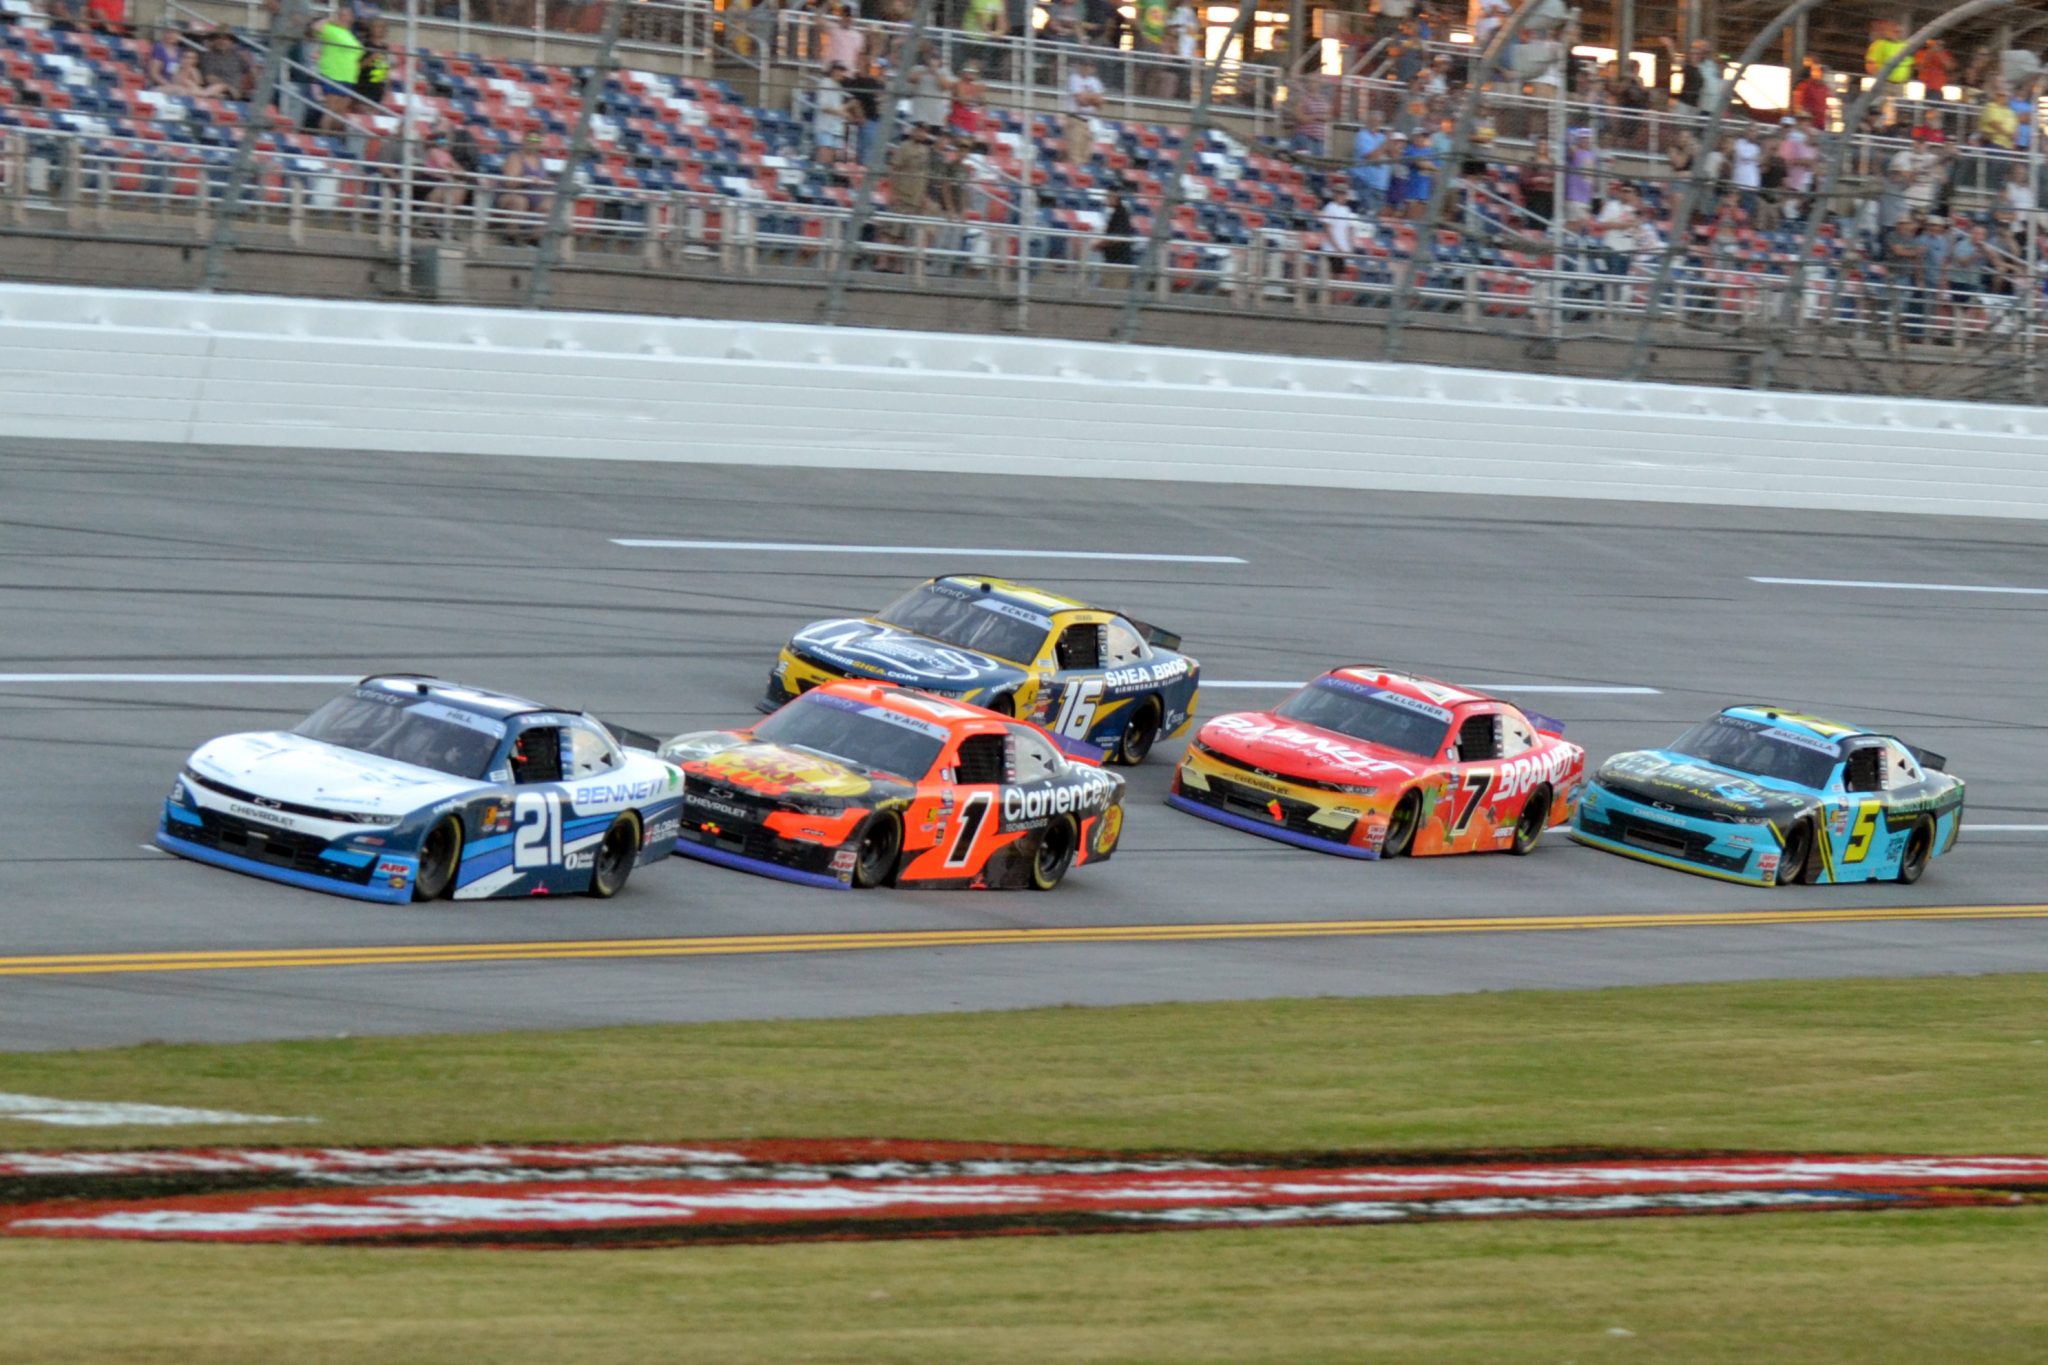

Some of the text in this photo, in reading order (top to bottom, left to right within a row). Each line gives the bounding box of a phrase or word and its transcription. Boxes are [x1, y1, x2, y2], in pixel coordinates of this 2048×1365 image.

[1001, 604, 1038, 622] ECKES
[1104, 658, 1188, 688] SHEA BROS
[446, 710, 473, 724] HILL
[1055, 678, 1104, 740] 16
[1386, 692, 1443, 717] ALLGAIER
[883, 711, 930, 732] KVAPIL
[1233, 773, 1290, 795] CHEVROLET
[1491, 742, 1576, 802] BRANDT
[686, 794, 747, 819] CHEVROLET
[1004, 779, 1102, 822] Clarience
[1450, 766, 1495, 837] 7
[230, 803, 296, 827] CHEVROLET
[1631, 806, 1688, 827] CHEVROLET
[514, 791, 562, 869] 21
[944, 791, 993, 868] 1
[1842, 800, 1883, 864] 5
